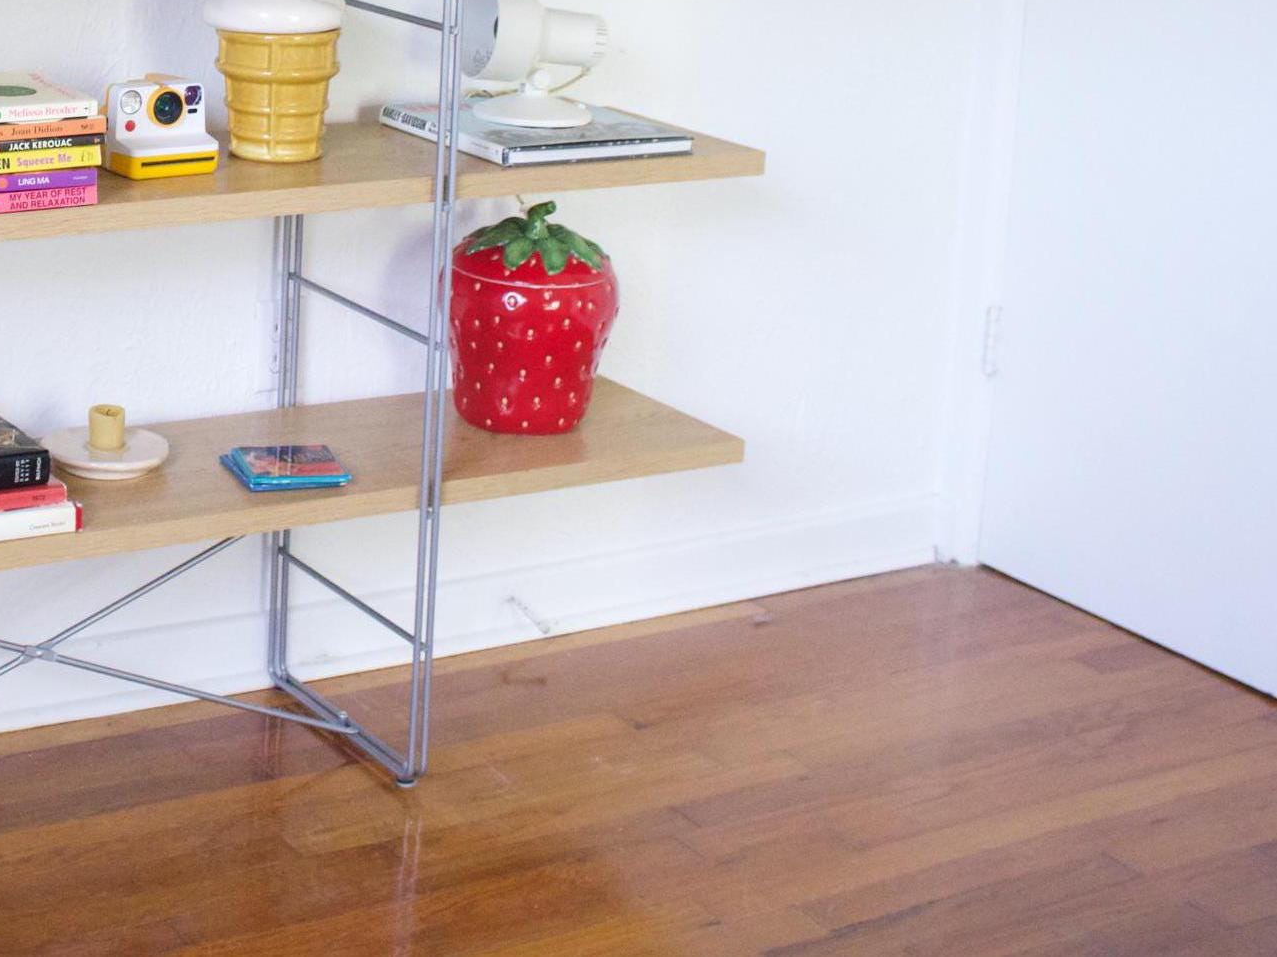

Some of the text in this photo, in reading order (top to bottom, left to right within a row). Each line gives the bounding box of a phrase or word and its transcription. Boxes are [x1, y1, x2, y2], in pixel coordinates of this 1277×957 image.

[11, 125, 64, 136] Joan Didion
[8, 138, 73, 152] JACK KEROUAC
[17, 156, 55, 167] Squeeze
[18, 175, 50, 186] LING MA
[9, 187, 86, 201] MY YEAR OF REST
[10, 196, 86, 210] AND RELAXATION
